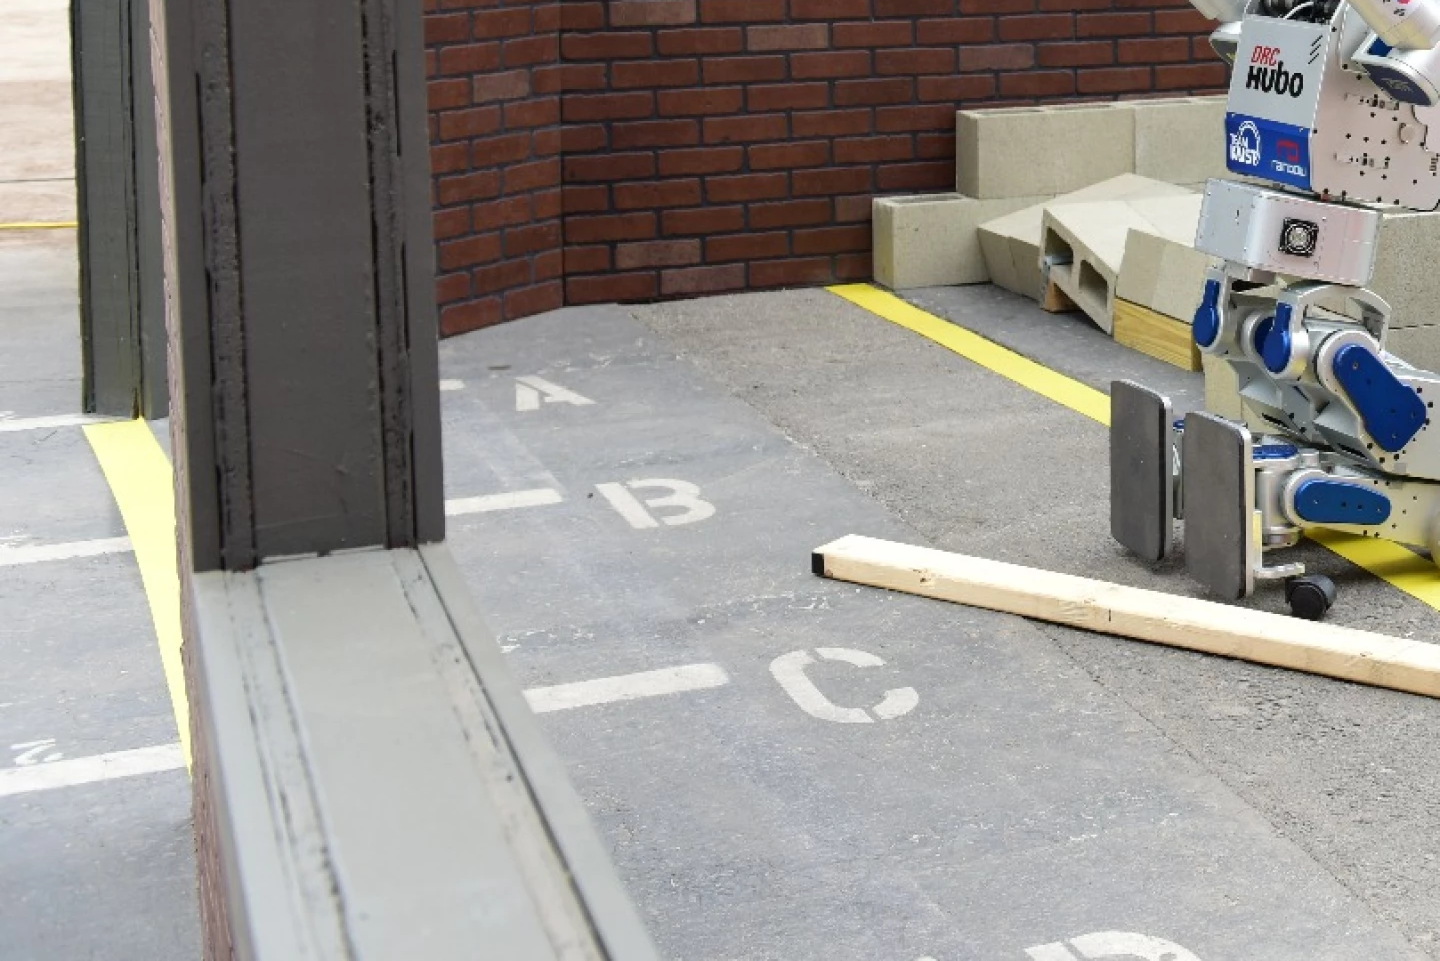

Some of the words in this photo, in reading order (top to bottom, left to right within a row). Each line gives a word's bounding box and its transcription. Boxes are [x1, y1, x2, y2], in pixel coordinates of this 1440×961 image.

[1251, 45, 1281, 66] DRC
[515, 375, 597, 411] A
[595, 478, 717, 529] B
[768, 647, 919, 723] C
